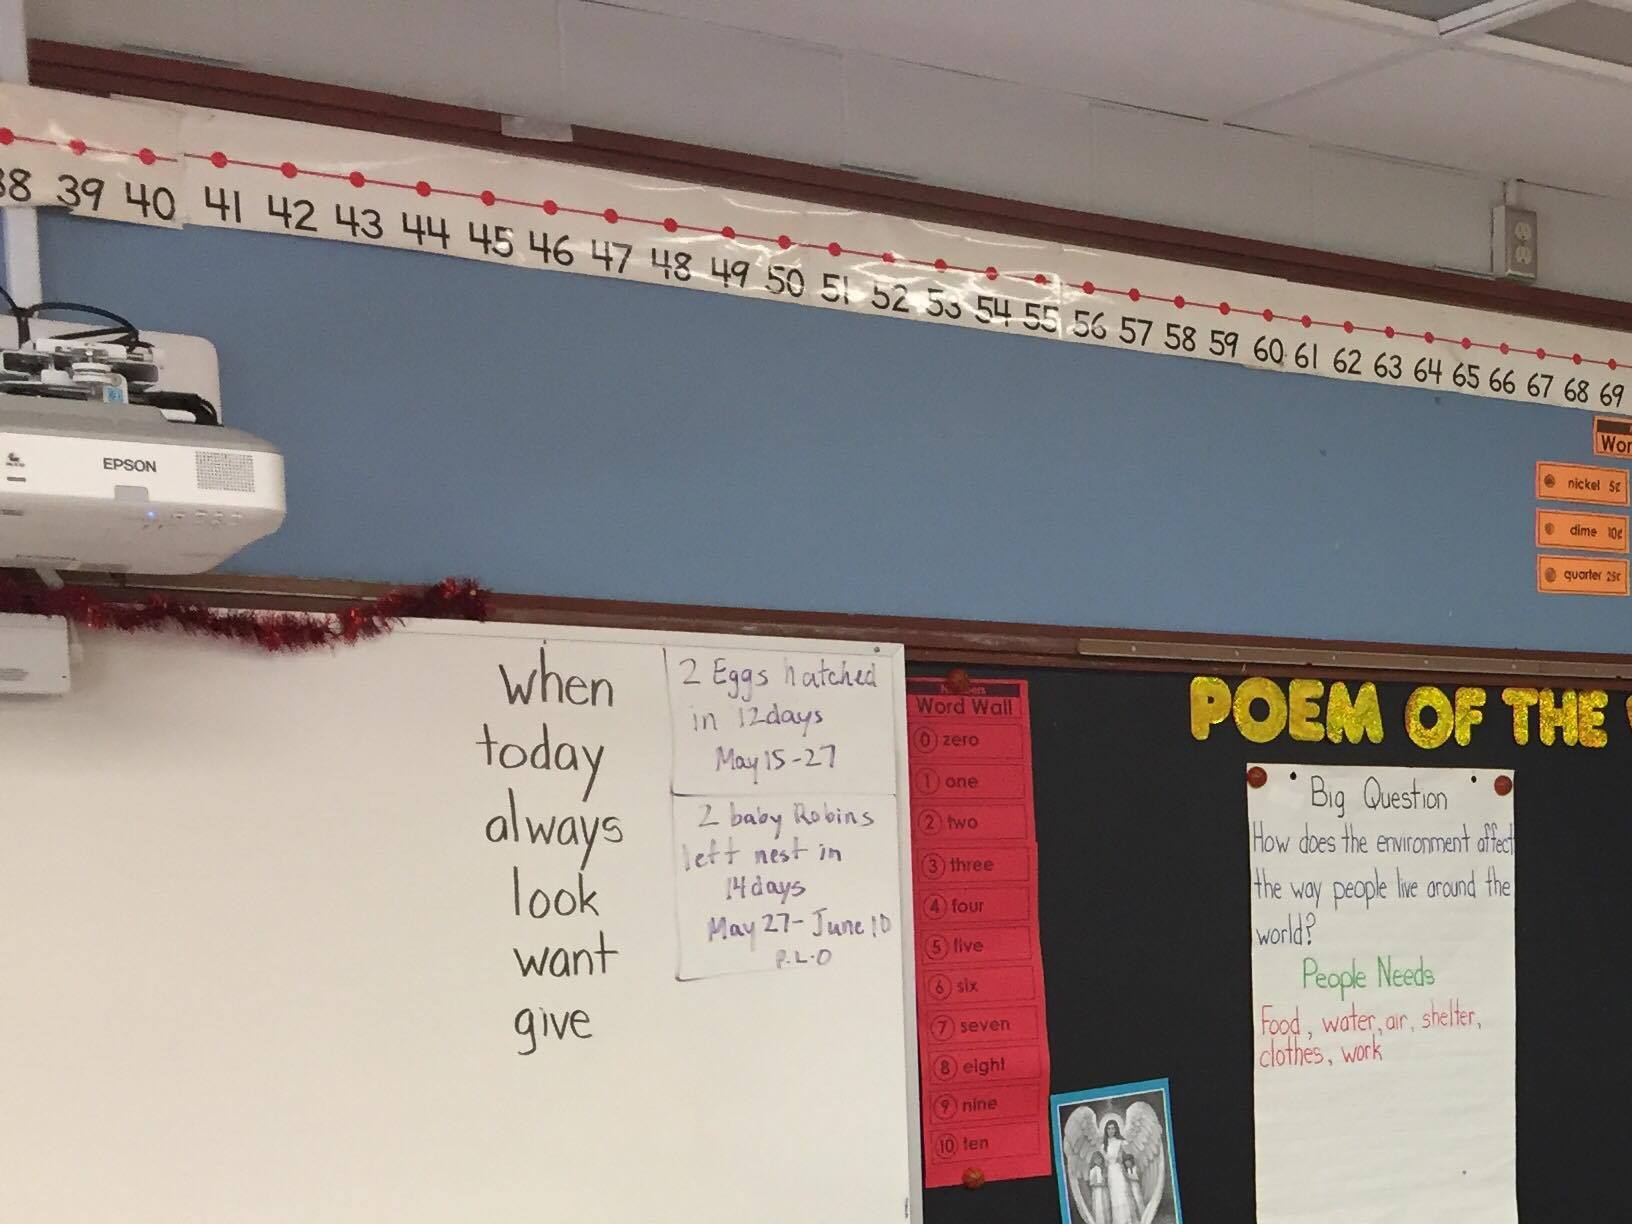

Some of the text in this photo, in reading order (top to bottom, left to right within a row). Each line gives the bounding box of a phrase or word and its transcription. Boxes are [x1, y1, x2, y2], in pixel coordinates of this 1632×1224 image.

[125, 182, 449, 250] 40 41 42 44
[1164, 324, 1283, 363] 58 60
[103, 458, 156, 473] EPSON
[1568, 479, 1600, 491] nickel
[1570, 524, 1597, 537] dime
[1564, 570, 1602, 582] quarter
[499, 647, 613, 706] when
[713, 663, 768, 701] Eggs
[917, 699, 1012, 716] Word Wall
[1190, 676, 1384, 744] POEM
[1405, 686, 1486, 749] OF
[1502, 688, 1608, 748] THE
[476, 723, 604, 802] today
[1311, 775, 1448, 818] Big Question
[486, 788, 623, 870] always
[730, 802, 874, 839] baby Robins
[1253, 821, 1471, 855] How does the environment
[950, 857, 995, 872] three
[514, 866, 599, 917] look
[1254, 866, 1512, 910] the way people around the
[812, 909, 865, 937] June
[1255, 914, 1316, 946] world?
[513, 931, 619, 977] want
[1302, 956, 1435, 1000] People Needs
[514, 1006, 592, 1055] give
[960, 1018, 1010, 1032] seven
[1341, 1041, 1383, 1062] work
